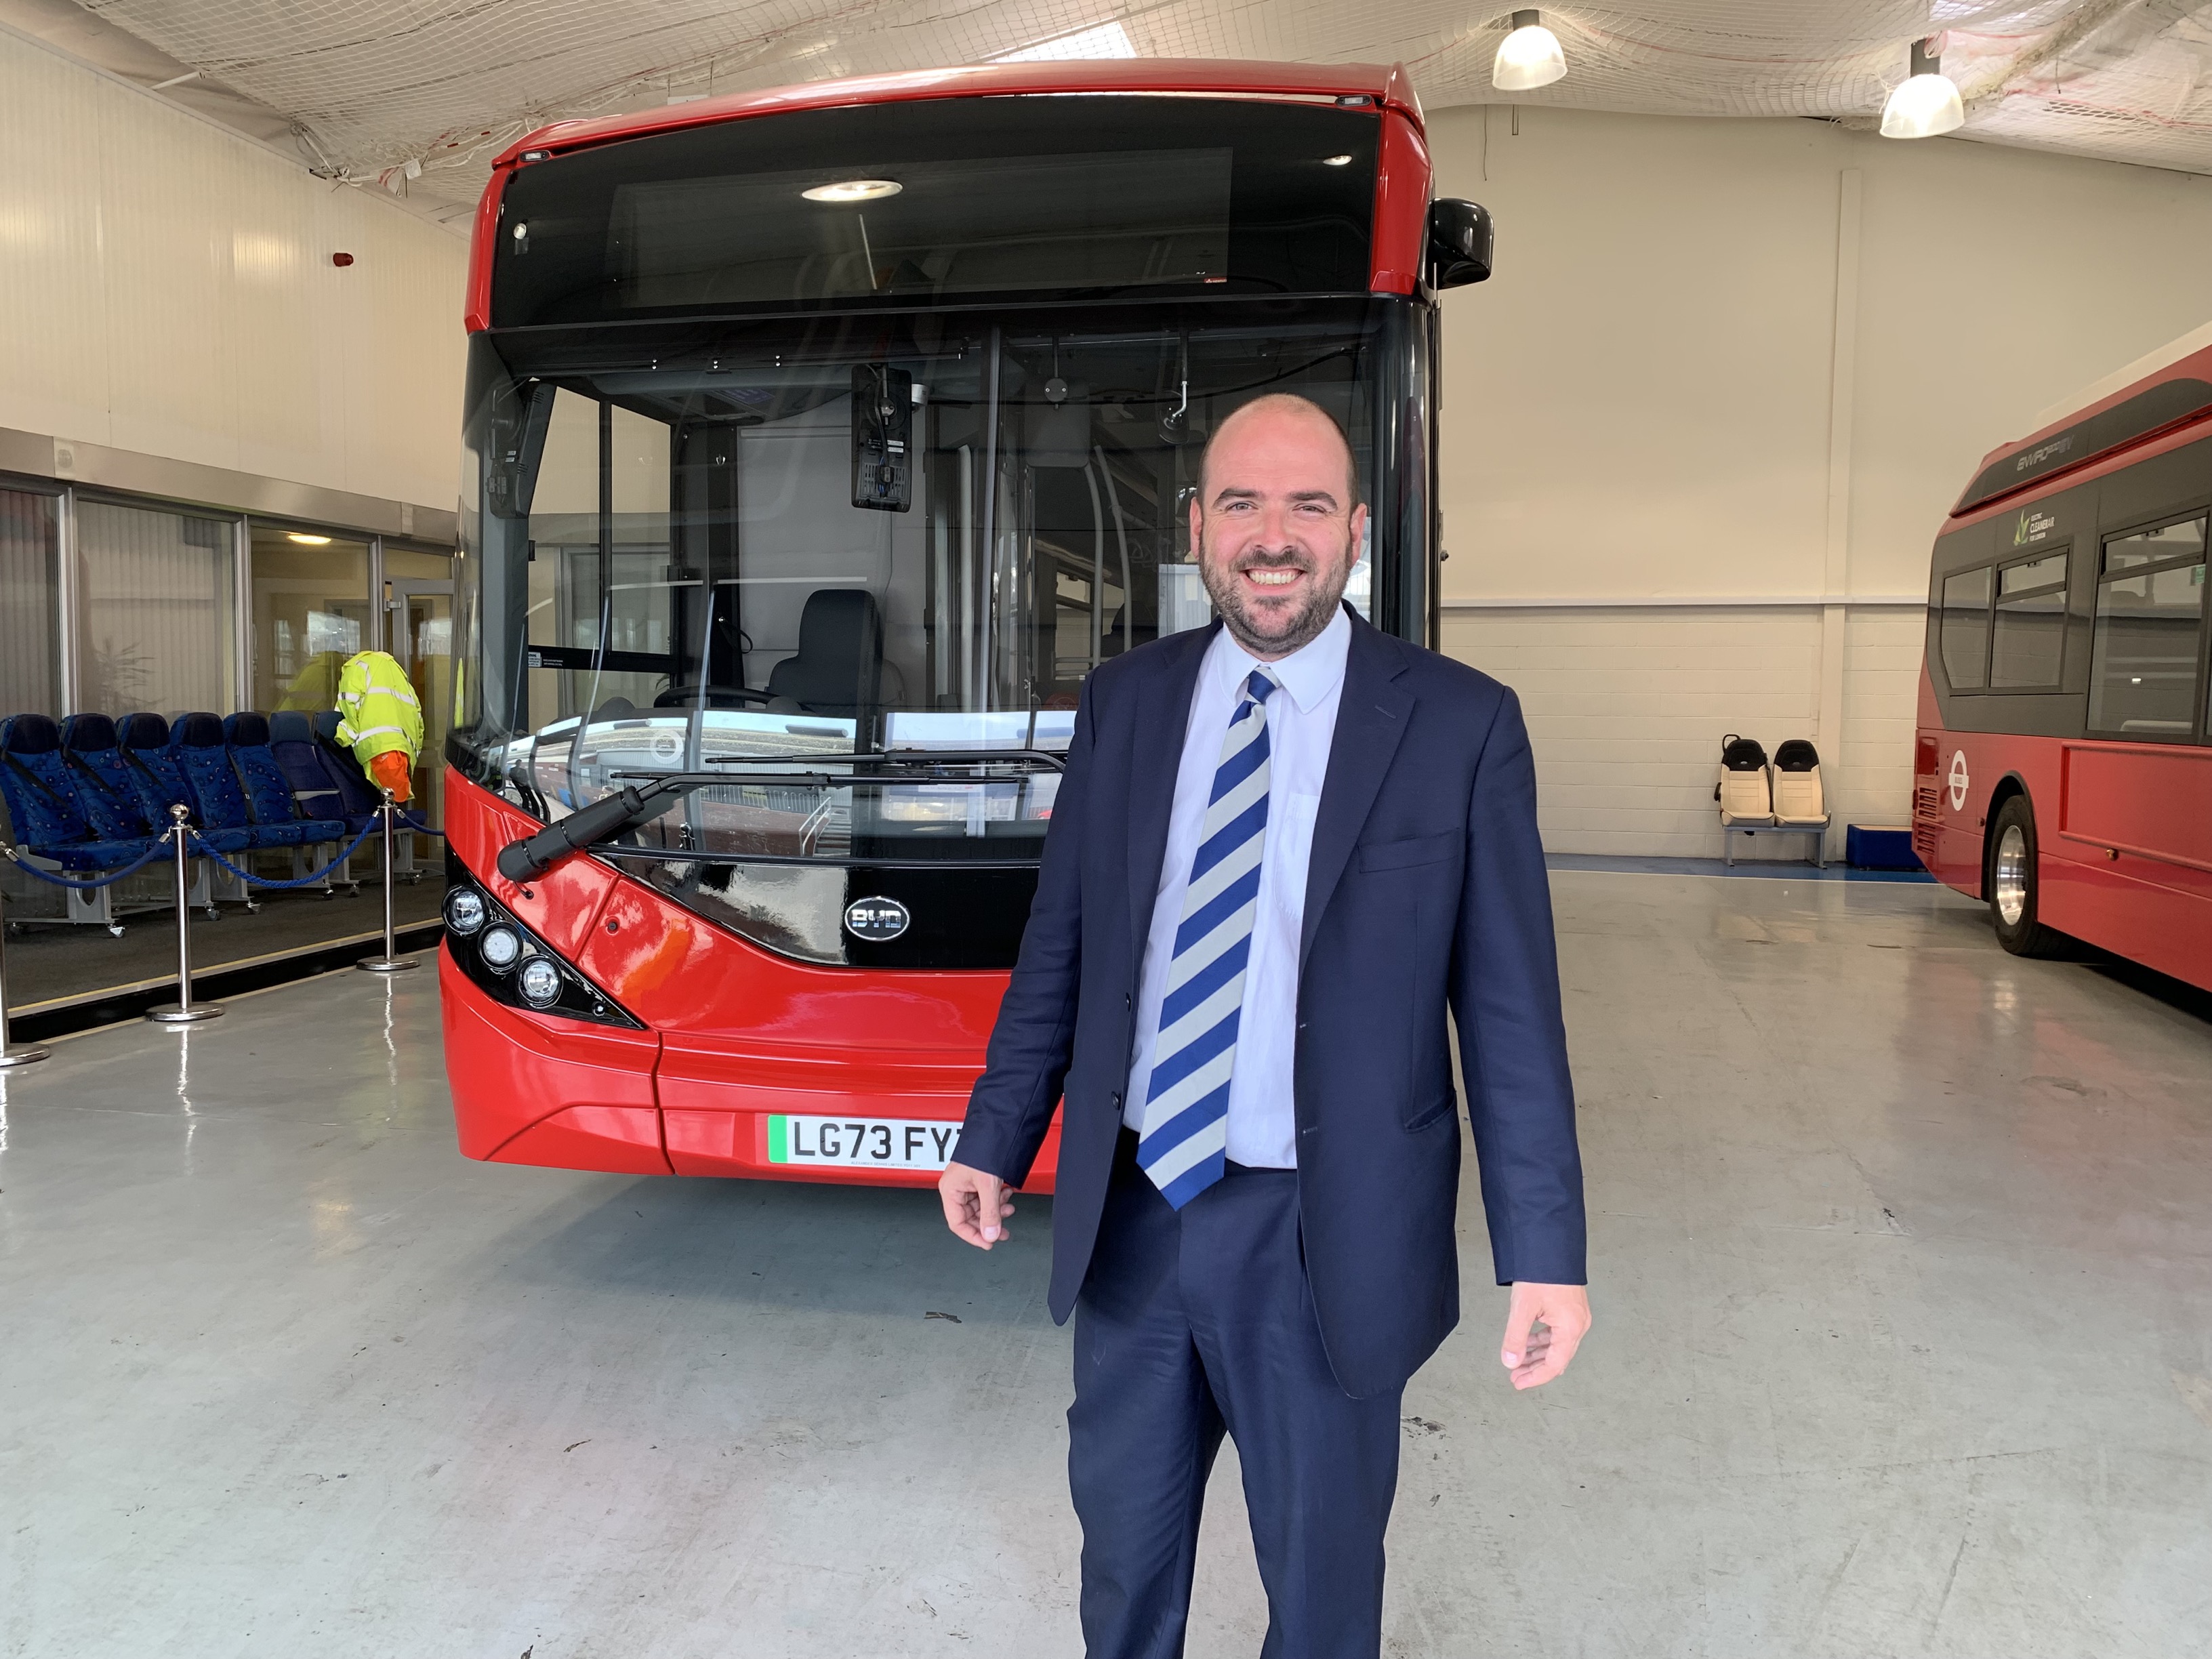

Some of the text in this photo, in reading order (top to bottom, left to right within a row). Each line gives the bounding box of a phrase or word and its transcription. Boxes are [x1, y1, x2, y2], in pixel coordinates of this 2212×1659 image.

[851, 909, 901, 928] BYD
[794, 1121, 962, 1163] LG73 FY
